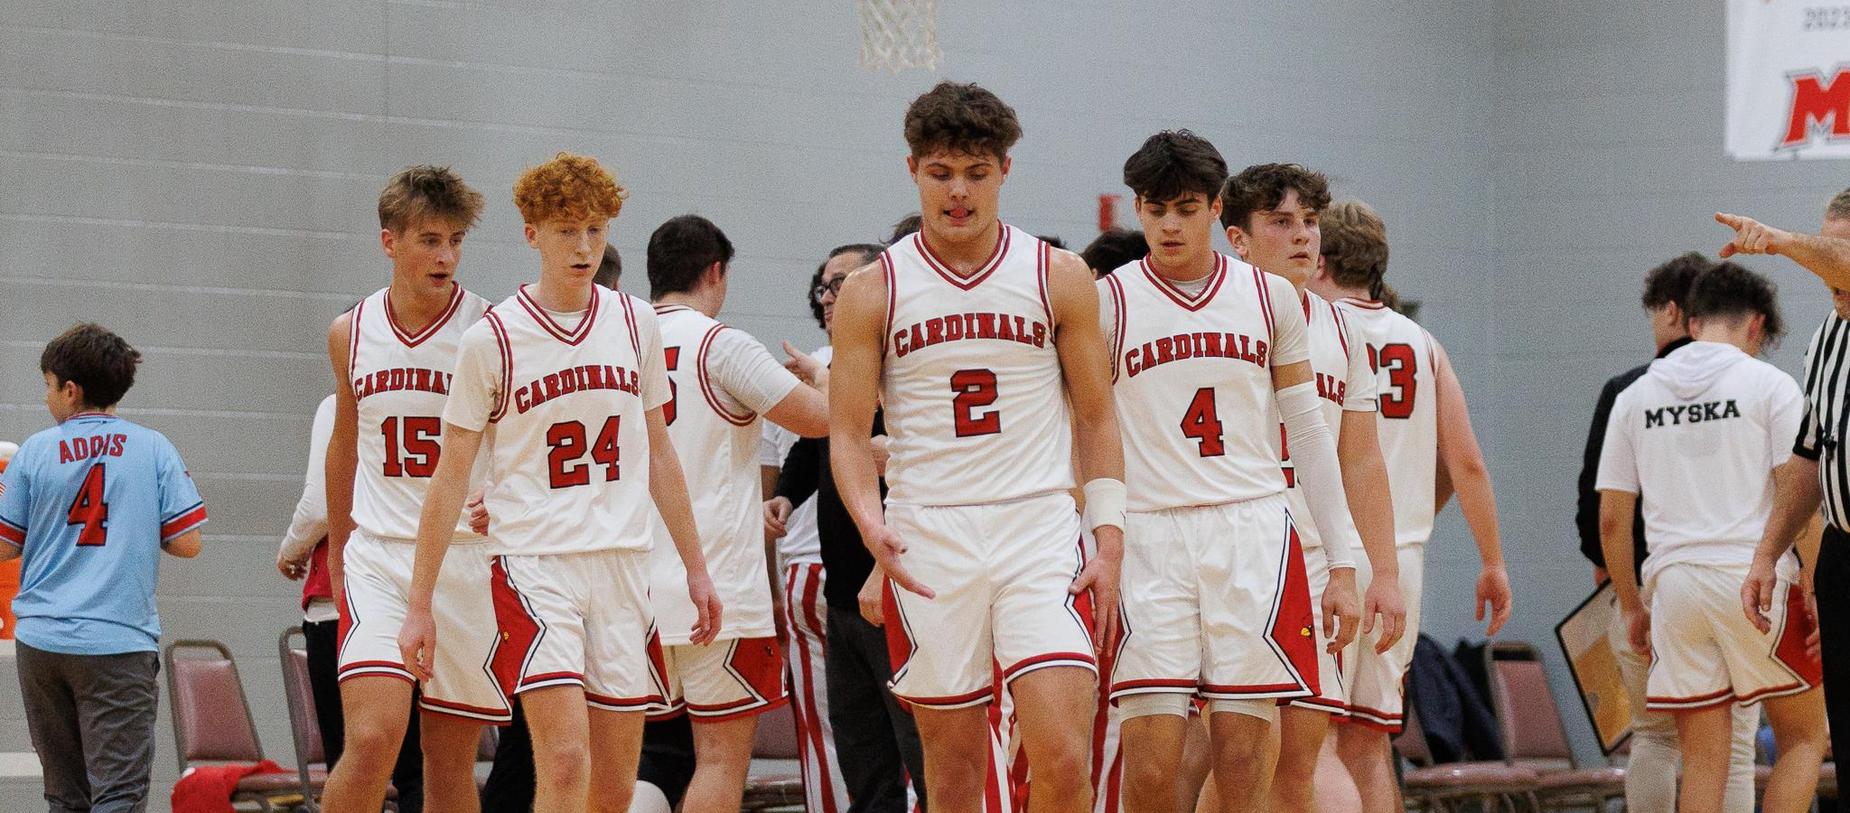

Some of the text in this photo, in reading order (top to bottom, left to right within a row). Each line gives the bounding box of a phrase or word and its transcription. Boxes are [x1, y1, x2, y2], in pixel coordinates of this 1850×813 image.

[893, 312, 1047, 358] CARDINALS
[1124, 332, 1268, 378] CARDINALS
[514, 364, 641, 414] CARDINALS
[950, 368, 1002, 438] 2
[1644, 399, 1741, 429] MYSKA
[59, 433, 127, 465] ADDIS
[380, 415, 441, 478] 15
[1180, 387, 1225, 458] 4
[546, 414, 621, 489] 24
[67, 462, 109, 547] 4
